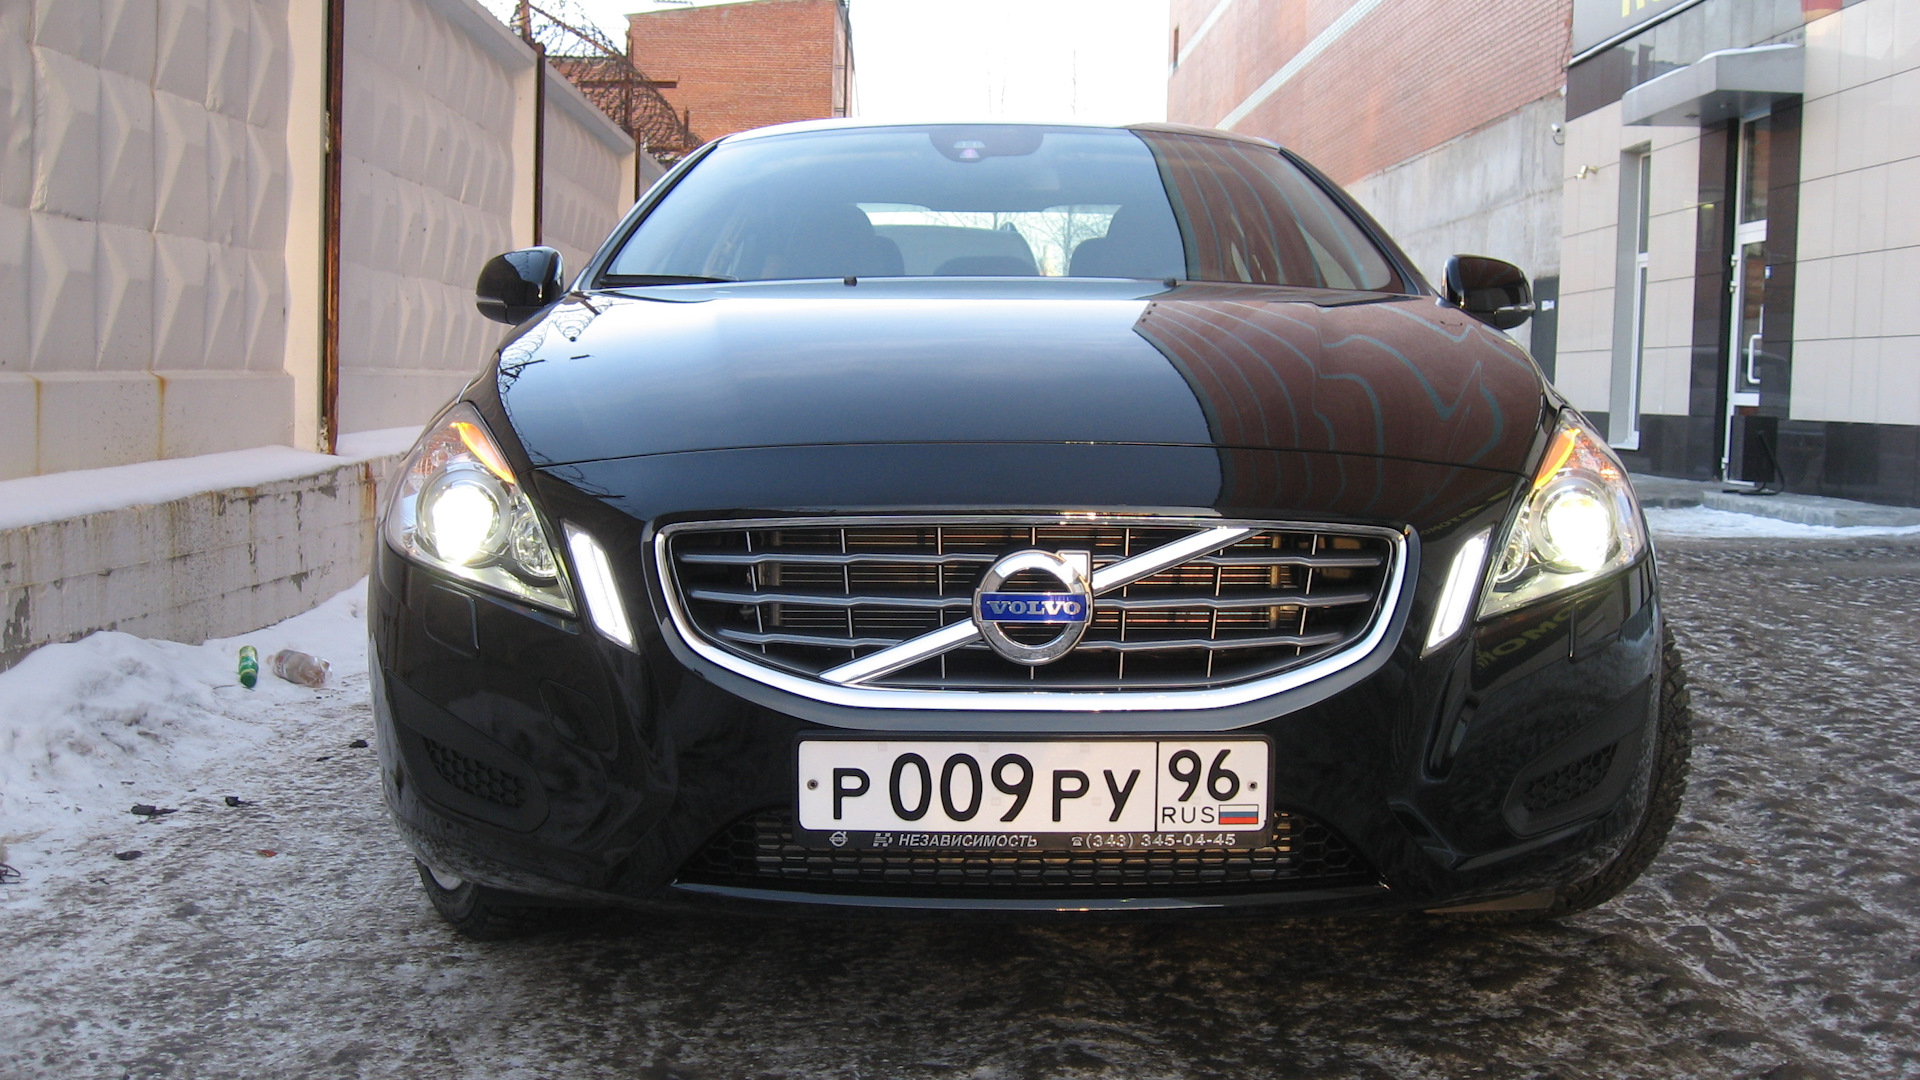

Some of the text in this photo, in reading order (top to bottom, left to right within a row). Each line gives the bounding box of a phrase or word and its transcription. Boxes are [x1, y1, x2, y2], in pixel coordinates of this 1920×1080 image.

[986, 600, 1081, 616] VOLVO
[1168, 749, 1241, 803] 96
[1161, 806, 1215, 824] RUS
[898, 833, 1038, 848] НЕЗАВИСИМОСТЬ
[1085, 832, 1236, 849] (343) 345-04-45
